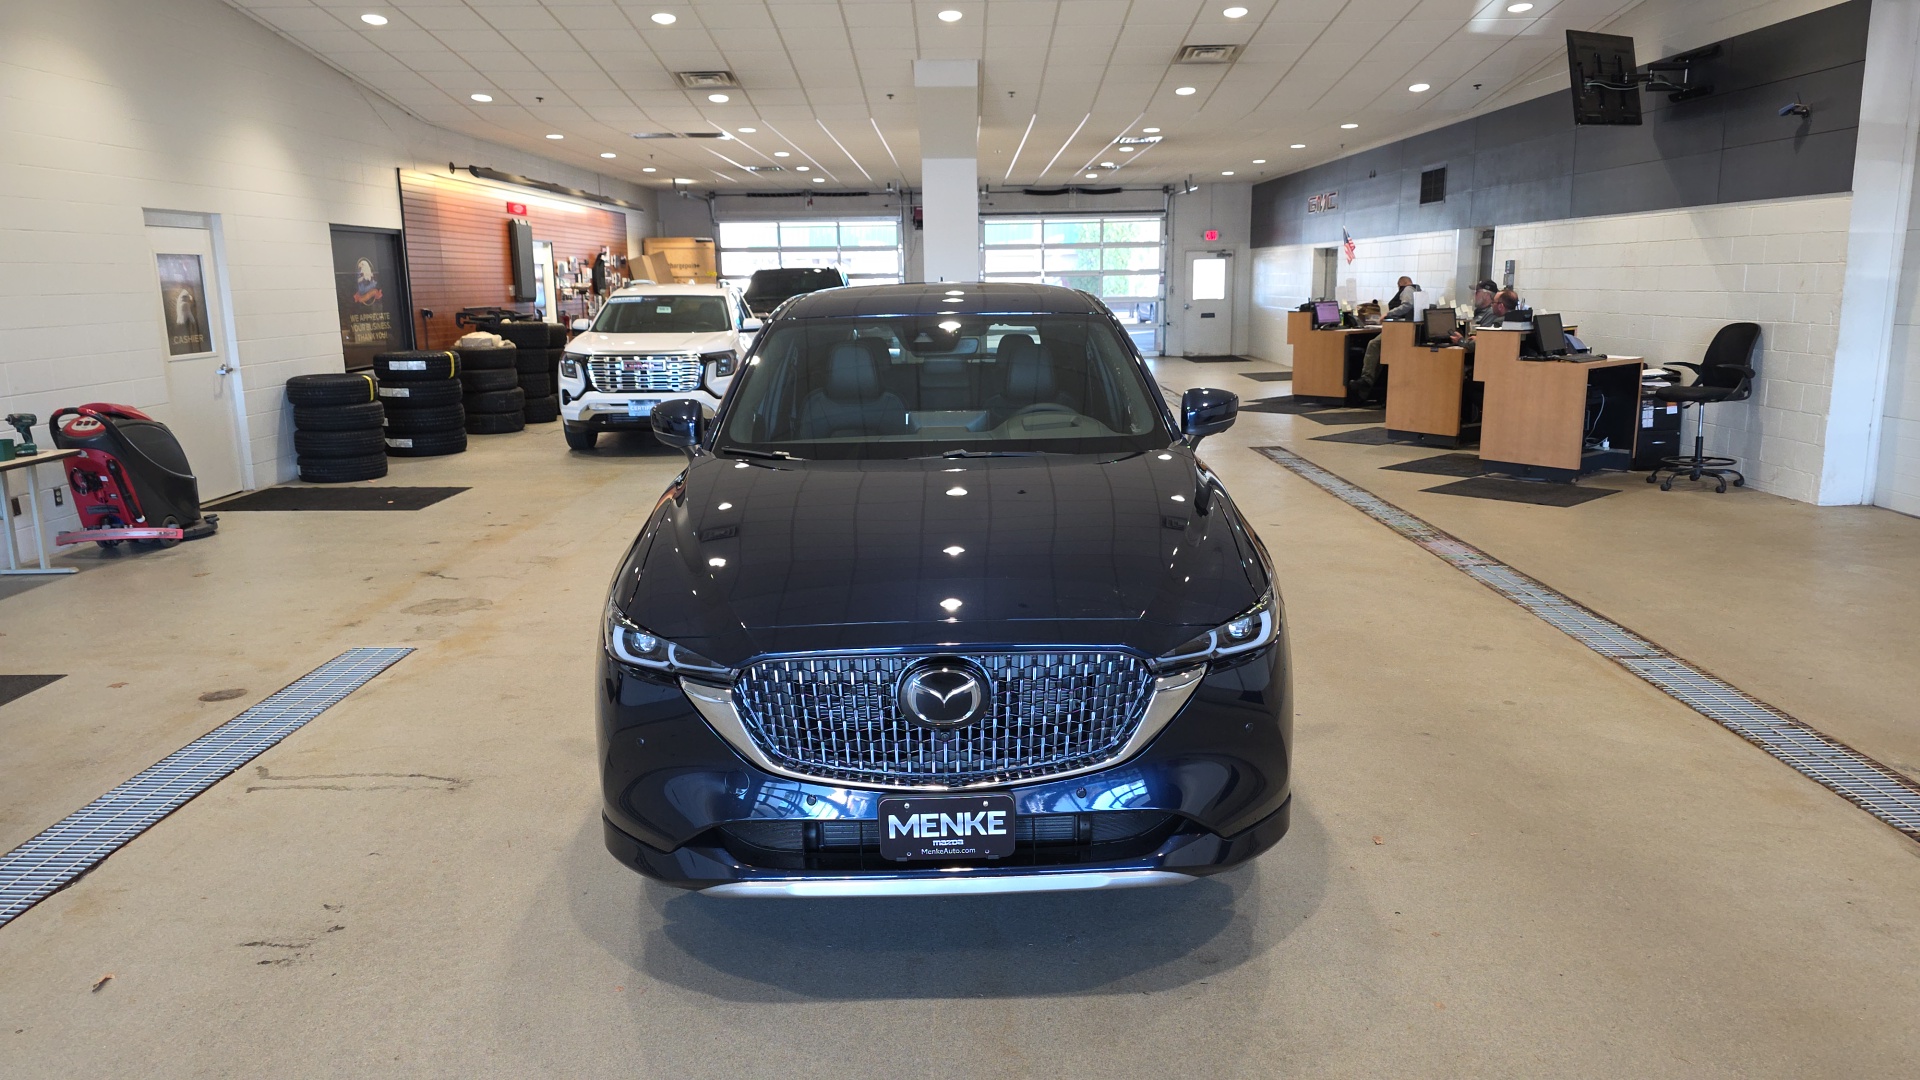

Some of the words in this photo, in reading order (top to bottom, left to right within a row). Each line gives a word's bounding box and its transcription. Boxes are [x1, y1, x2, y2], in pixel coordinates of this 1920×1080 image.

[1308, 191, 1339, 214] GMC
[350, 314, 359, 322] WE
[360, 312, 390, 321] APPRECIATE
[351, 323, 366, 333] YOUR
[173, 335, 204, 344] CASHIER
[358, 333, 375, 341] THANK
[888, 810, 1007, 839] MENKE
[921, 847, 976, 855] MenkeAuto.com
